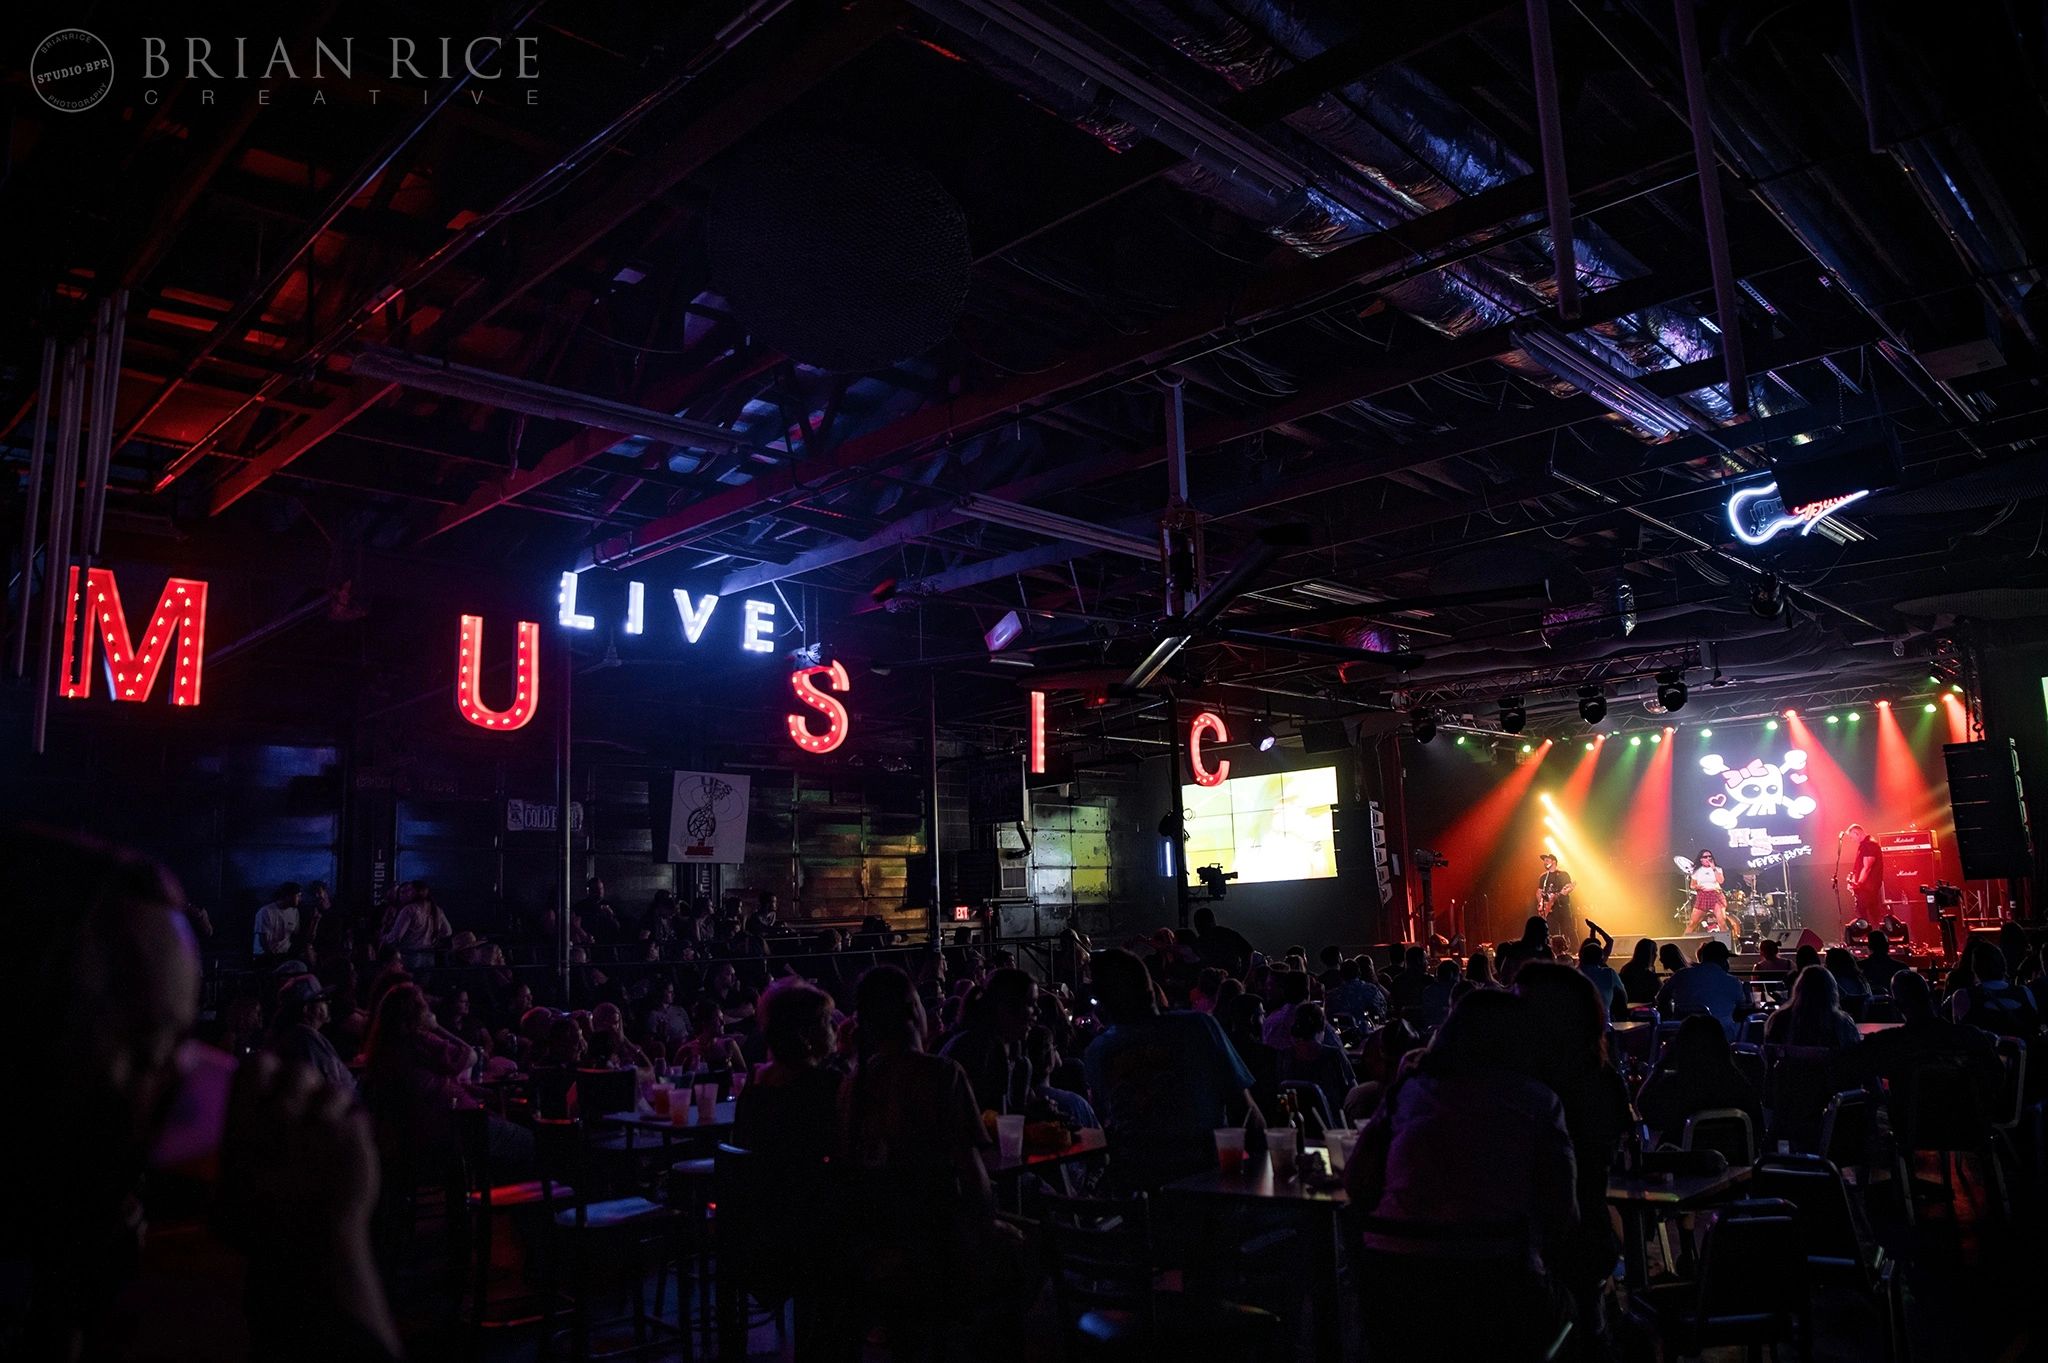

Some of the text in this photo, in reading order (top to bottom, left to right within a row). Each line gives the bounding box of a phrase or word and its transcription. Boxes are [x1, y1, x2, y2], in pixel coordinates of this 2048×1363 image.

[558, 570, 776, 654] LIVE
[58, 565, 1232, 788] MUSIC
[1747, 852, 1783, 868] NEVER
